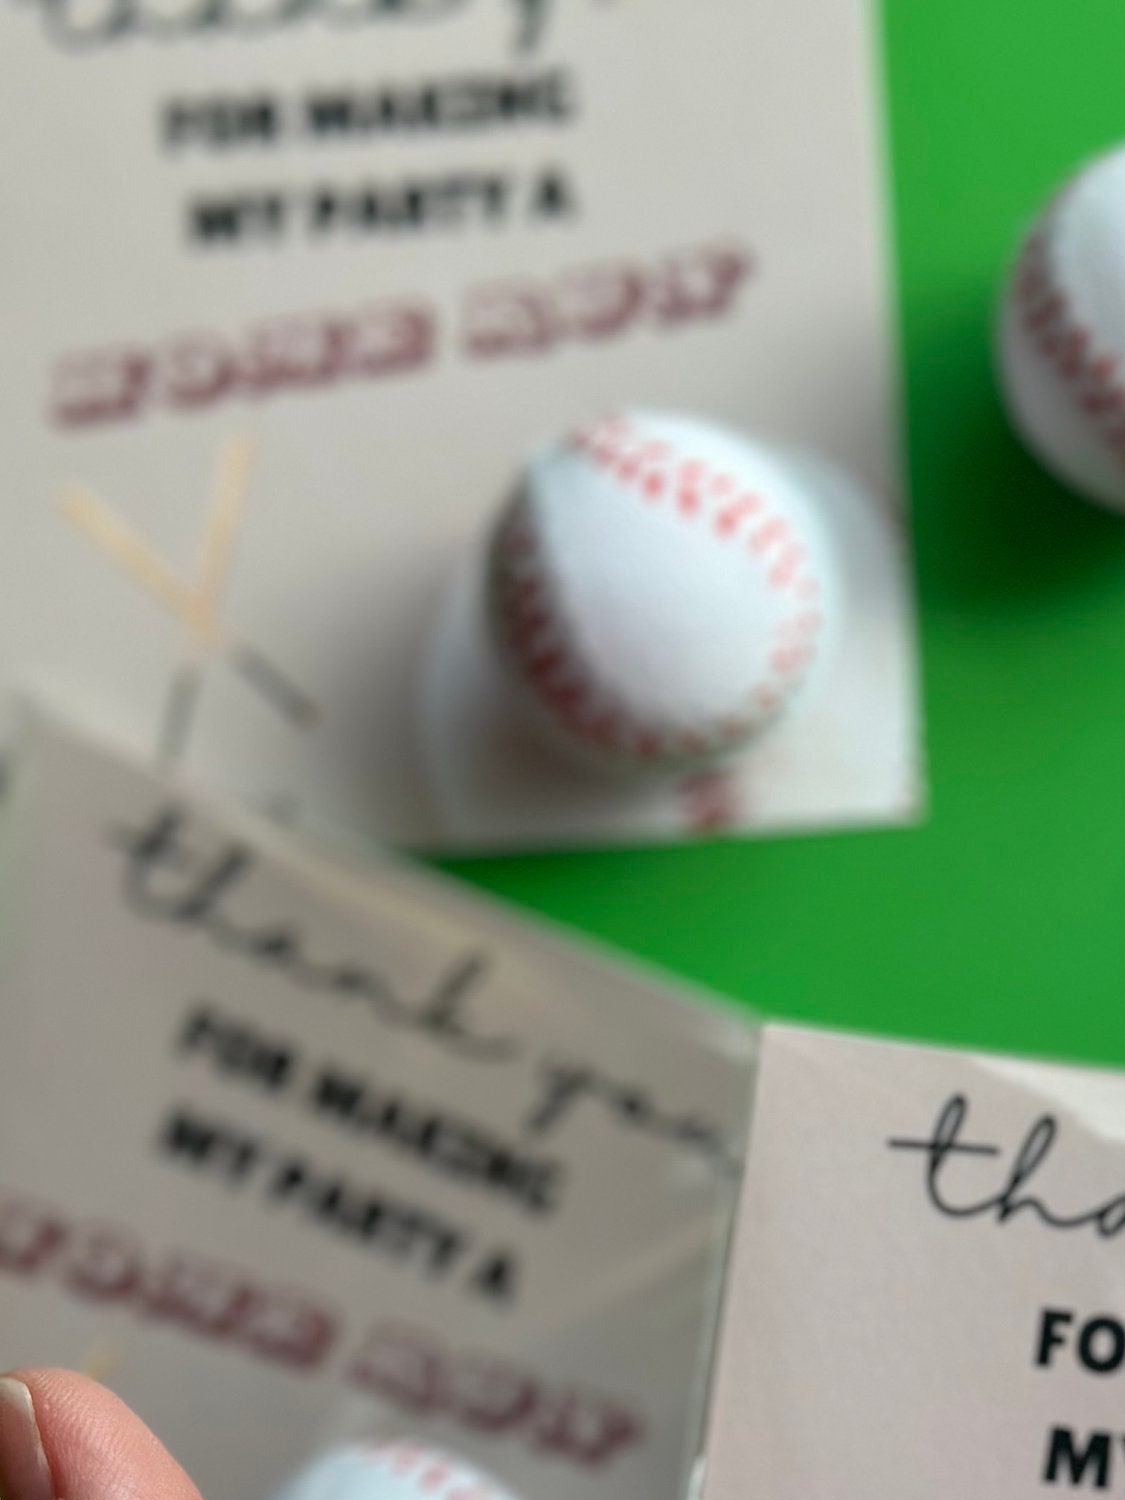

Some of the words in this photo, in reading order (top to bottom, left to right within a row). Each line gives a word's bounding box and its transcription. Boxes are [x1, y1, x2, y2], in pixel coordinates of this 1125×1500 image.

[166, 97, 277, 151] FOR
[307, 76, 572, 145] MAKING
[187, 190, 287, 250] MY
[307, 171, 513, 238] PARTY
[530, 167, 578, 222] A
[315, 1071, 561, 1213] MAKING
[266, 1157, 464, 1283] PARTY
